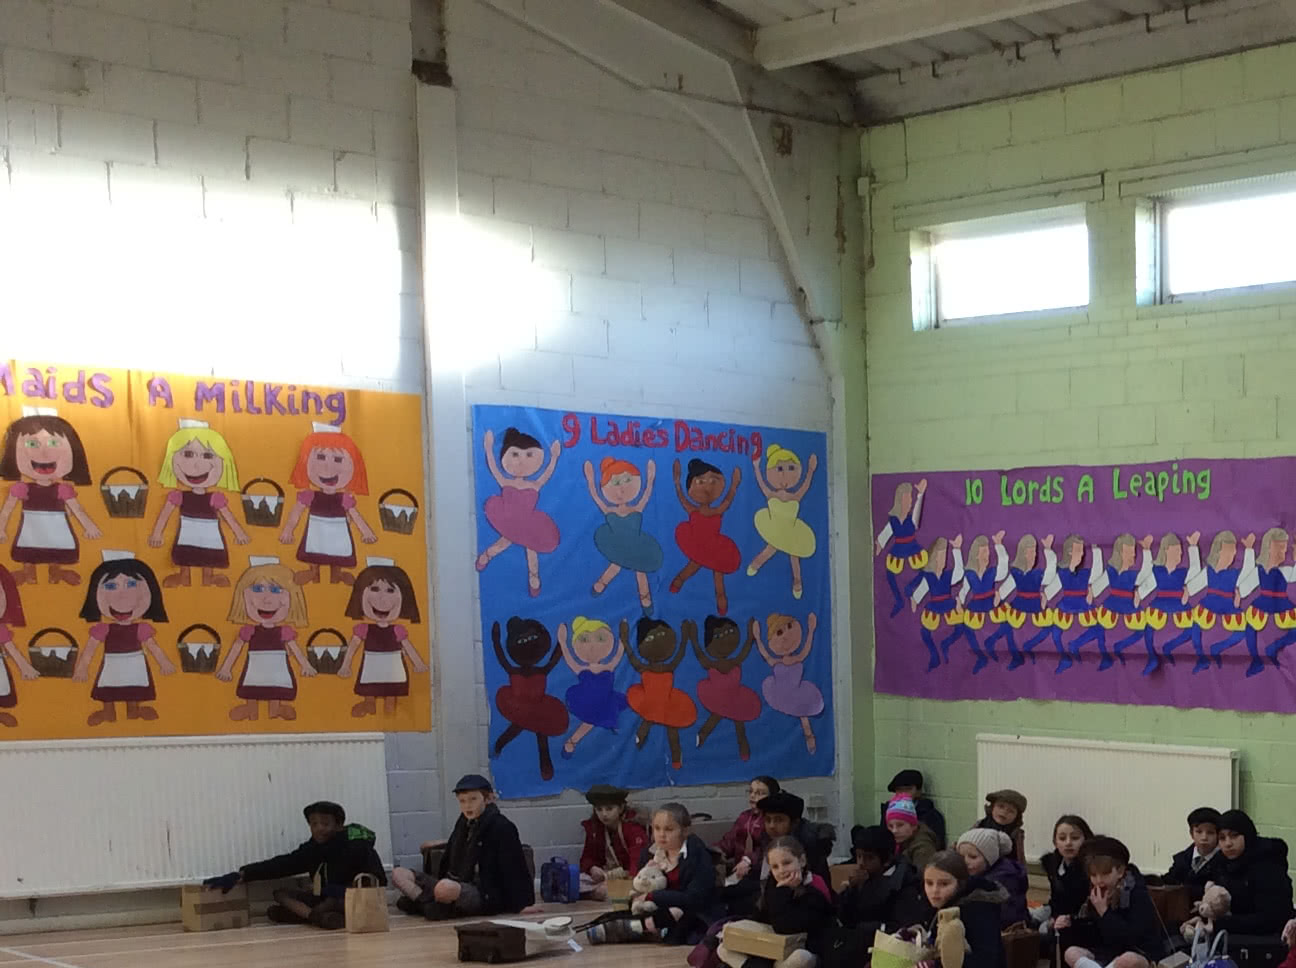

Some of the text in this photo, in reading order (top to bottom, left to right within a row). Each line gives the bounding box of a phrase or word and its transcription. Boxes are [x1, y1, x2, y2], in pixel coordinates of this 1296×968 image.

[147, 376, 174, 408] A
[194, 379, 346, 426] Milking
[562, 413, 763, 461] 9 Ladies Dancing
[965, 463, 1211, 506] 10 Lords A Leaping
